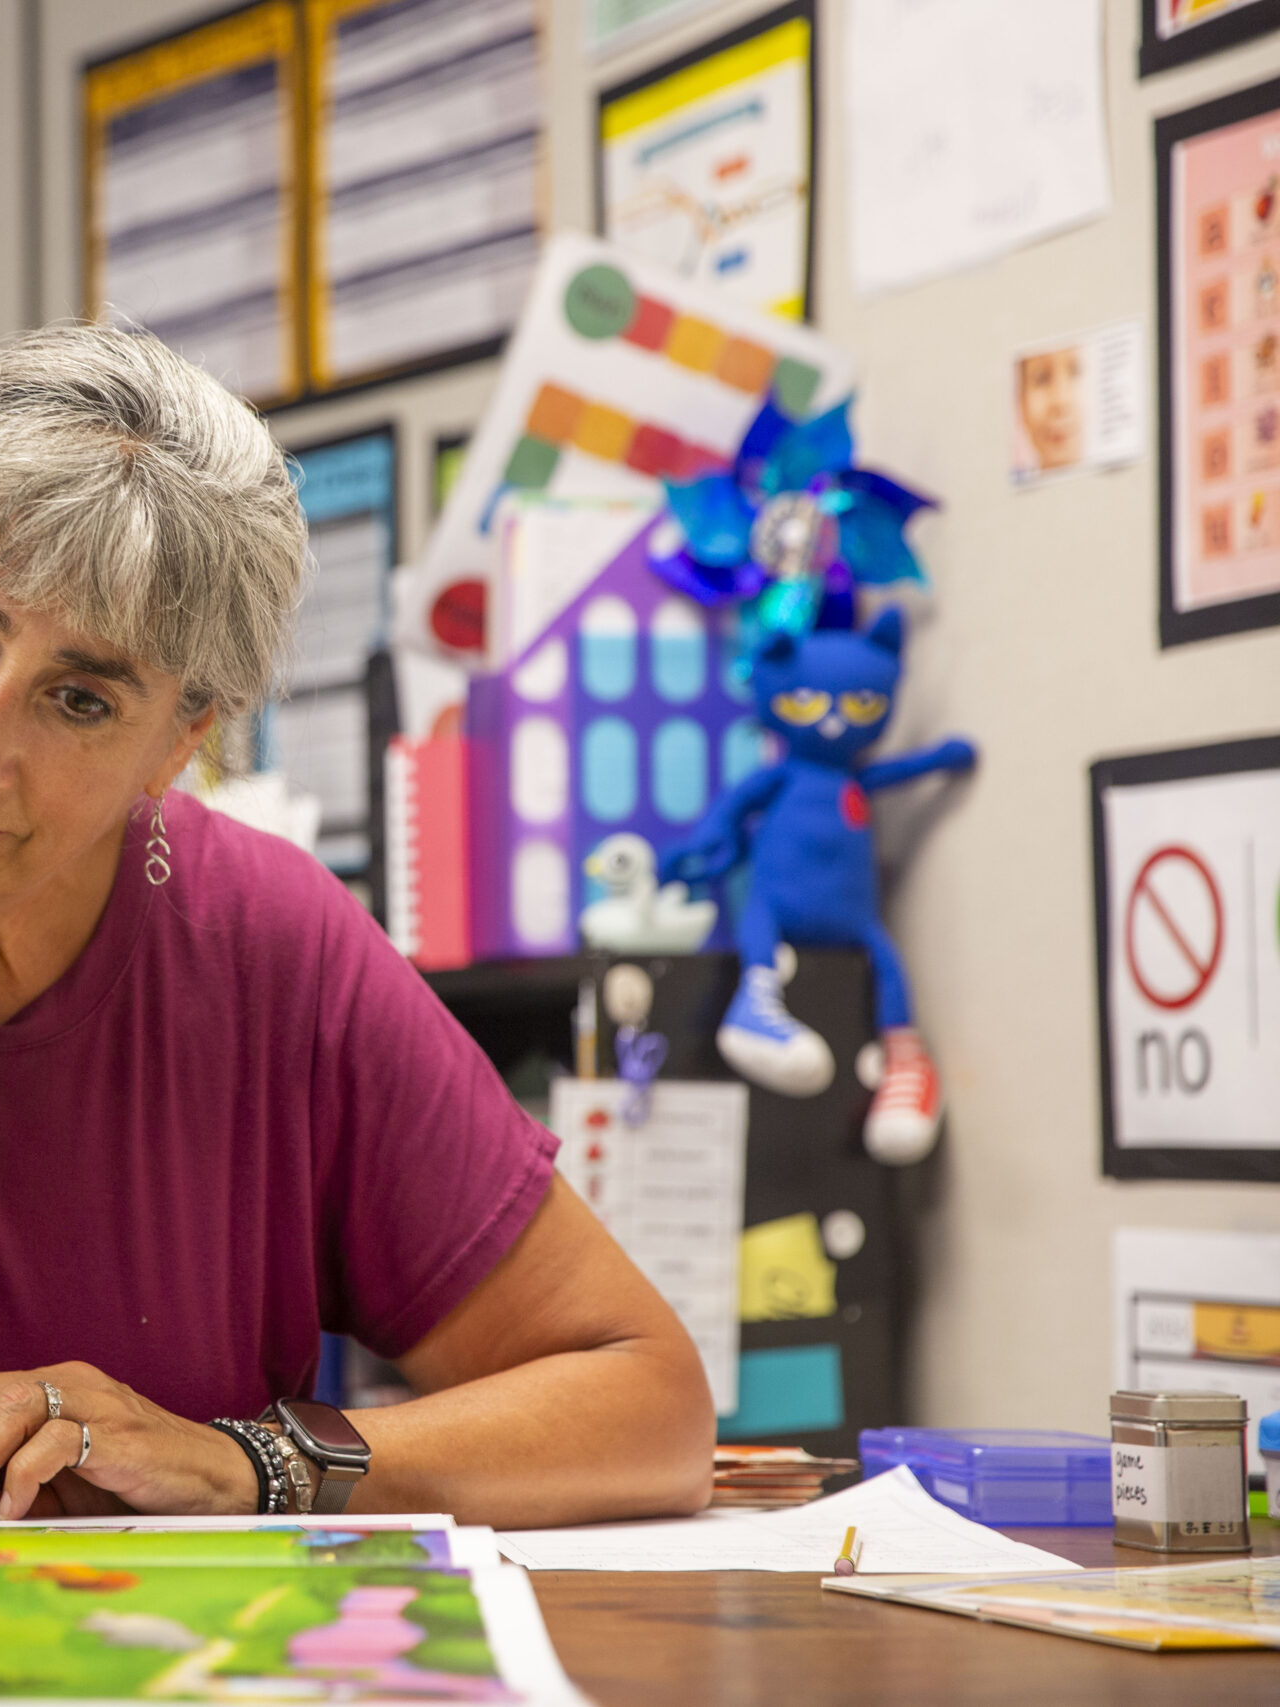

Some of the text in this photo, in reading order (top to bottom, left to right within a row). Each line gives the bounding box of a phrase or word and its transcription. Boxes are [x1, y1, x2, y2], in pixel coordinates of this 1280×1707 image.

[1137, 1026, 1211, 1096] no
[1116, 1451, 1144, 1477] game
[1116, 1481, 1147, 1505] pieces
